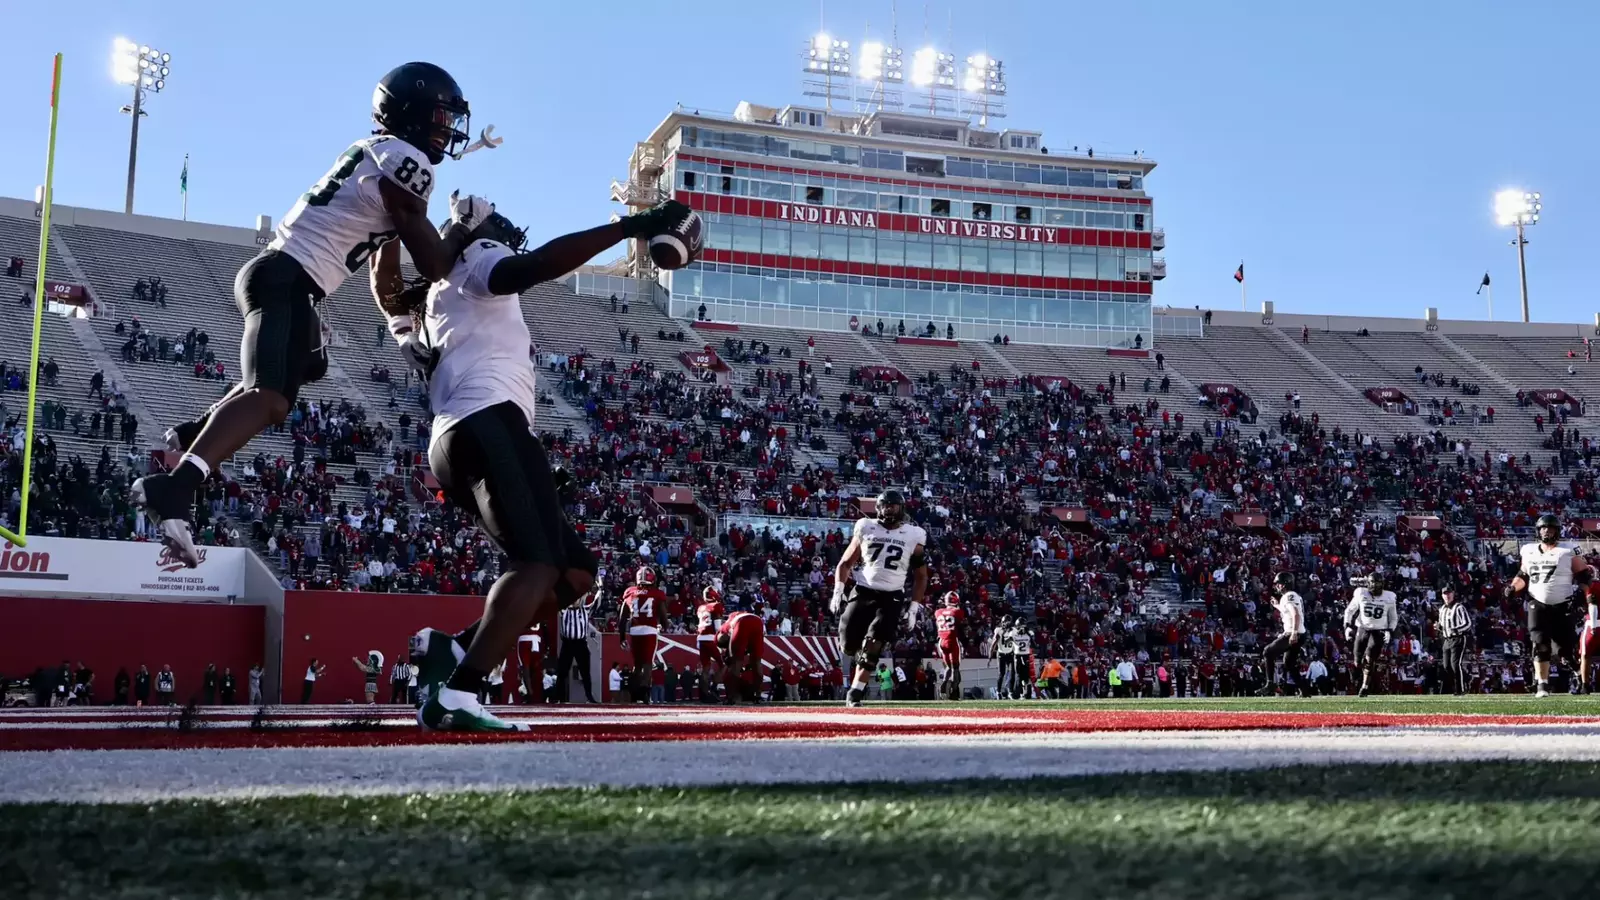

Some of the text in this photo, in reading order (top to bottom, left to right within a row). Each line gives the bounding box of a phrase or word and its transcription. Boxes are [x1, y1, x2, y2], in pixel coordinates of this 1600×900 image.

[394, 156, 432, 195] 83
[780, 204, 1058, 242] INDIANA UNIVERSITY
[54, 285, 71, 293] 102
[670, 492, 676, 501] 4
[1066, 511, 1072, 519] 6
[1247, 516, 1252, 525] 7
[1422, 520, 1428, 528] 8
[867, 543, 904, 570] 72
[1529, 565, 1557, 584] 67
[1363, 606, 1384, 619] 58
[937, 615, 955, 631] 22
[1019, 641, 1027, 652] 2
